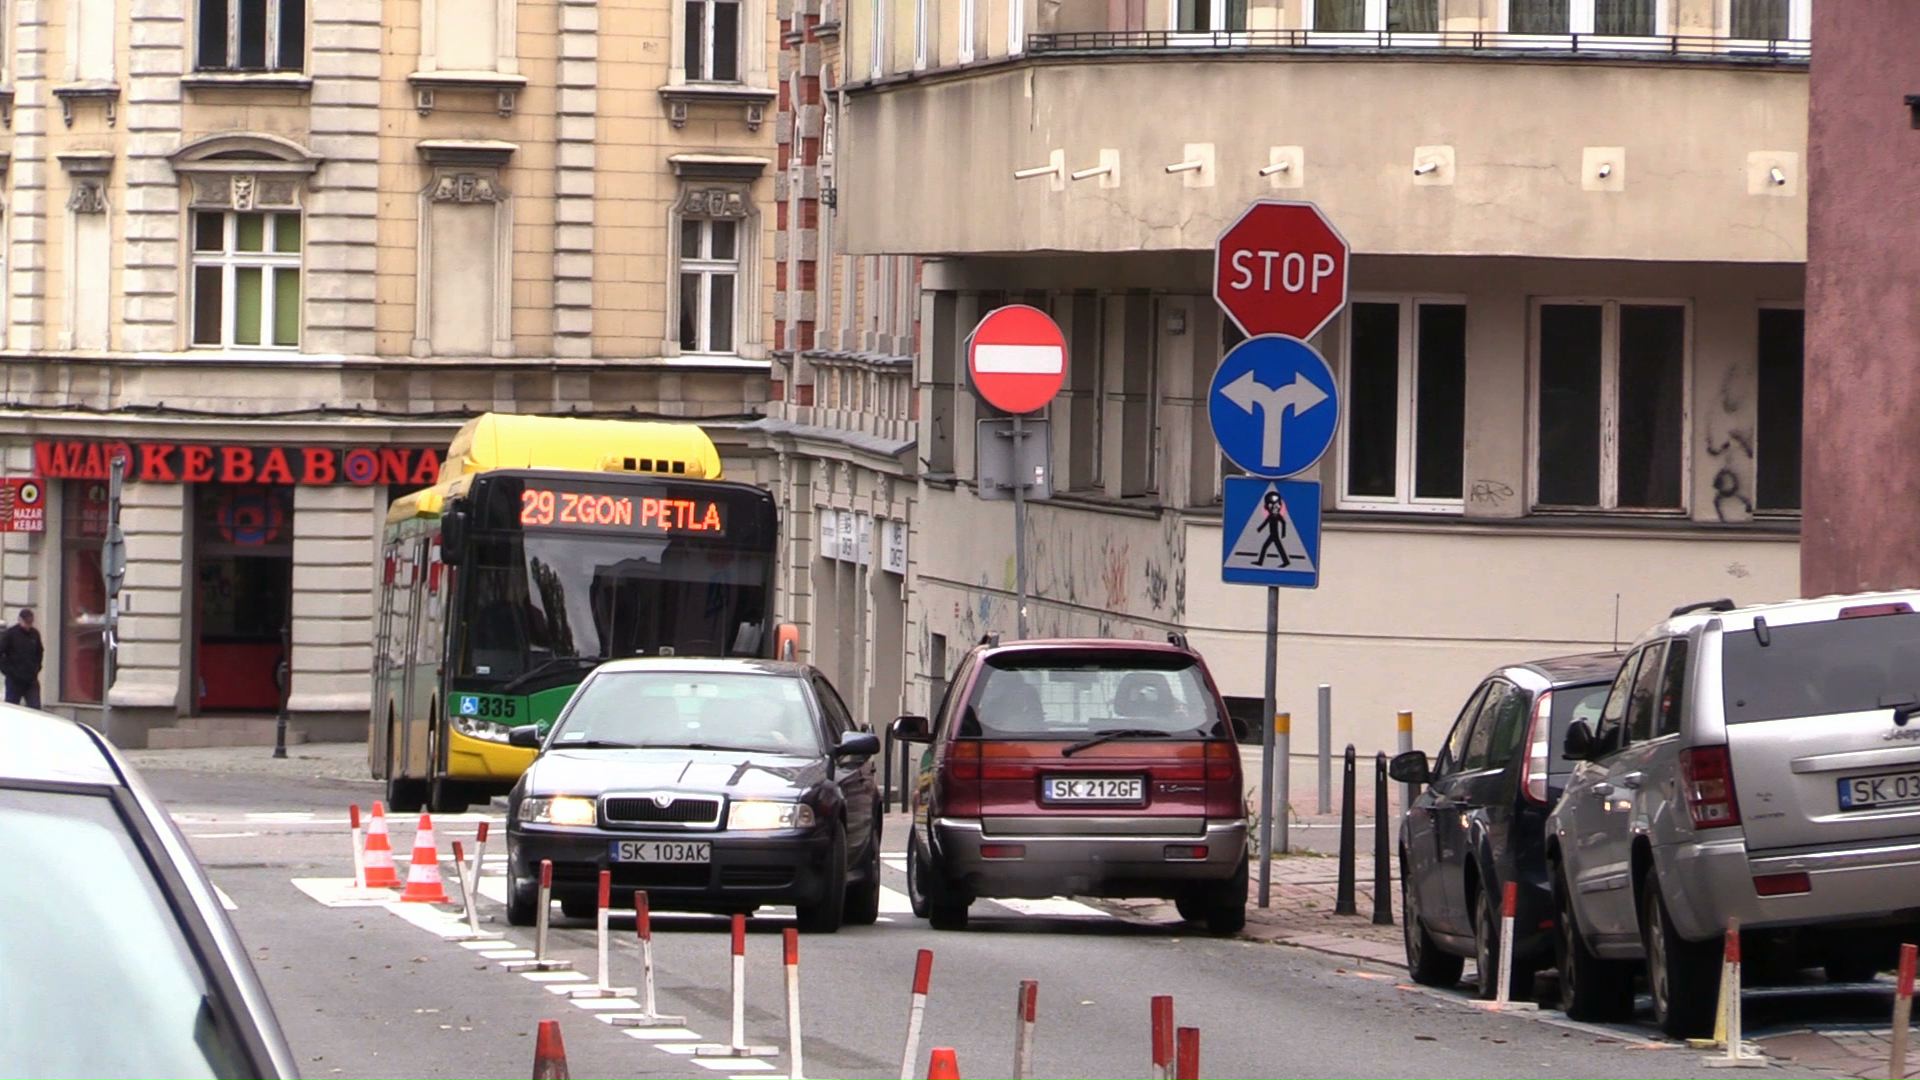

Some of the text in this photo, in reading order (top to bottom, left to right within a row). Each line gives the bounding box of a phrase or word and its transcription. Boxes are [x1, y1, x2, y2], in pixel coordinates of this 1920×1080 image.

[1230, 249, 1335, 294] STOP
[139, 444, 337, 484] KEBAB
[13, 507, 43, 520] NAZAR
[520, 489, 721, 531] 29 ZGOŃ PĘTLA
[13, 519, 43, 531] KEBAB
[479, 696, 516, 718] 335
[1055, 780, 1139, 797] SK 212GF
[1854, 778, 1887, 803] SK
[621, 843, 709, 861] SK 103AK
